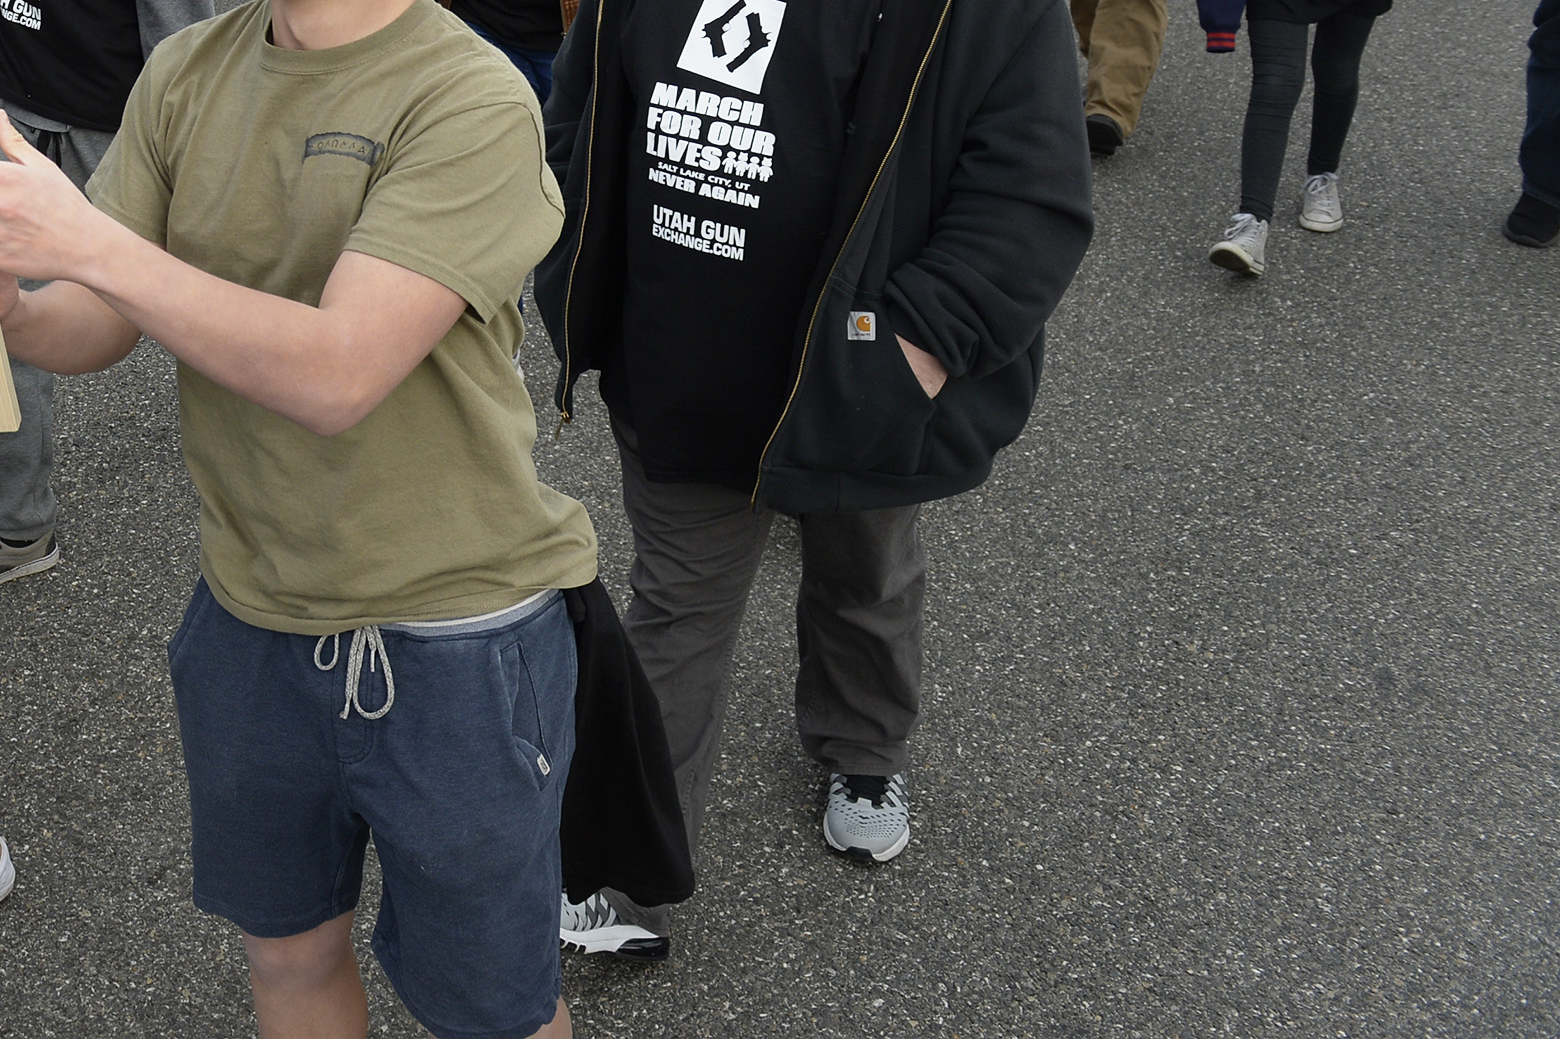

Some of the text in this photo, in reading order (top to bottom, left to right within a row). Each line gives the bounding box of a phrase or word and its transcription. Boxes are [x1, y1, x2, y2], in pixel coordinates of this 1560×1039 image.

[650, 81, 764, 126] MARCH
[646, 131, 723, 171] LIVES
[647, 106, 776, 157] FOR OUR
[648, 167, 760, 209] NEVER AGAIN
[658, 162, 751, 191] SALT LAKE CITY, UT
[652, 223, 744, 261] EXCHANGE.COM
[653, 204, 746, 248] UTAH GUN
